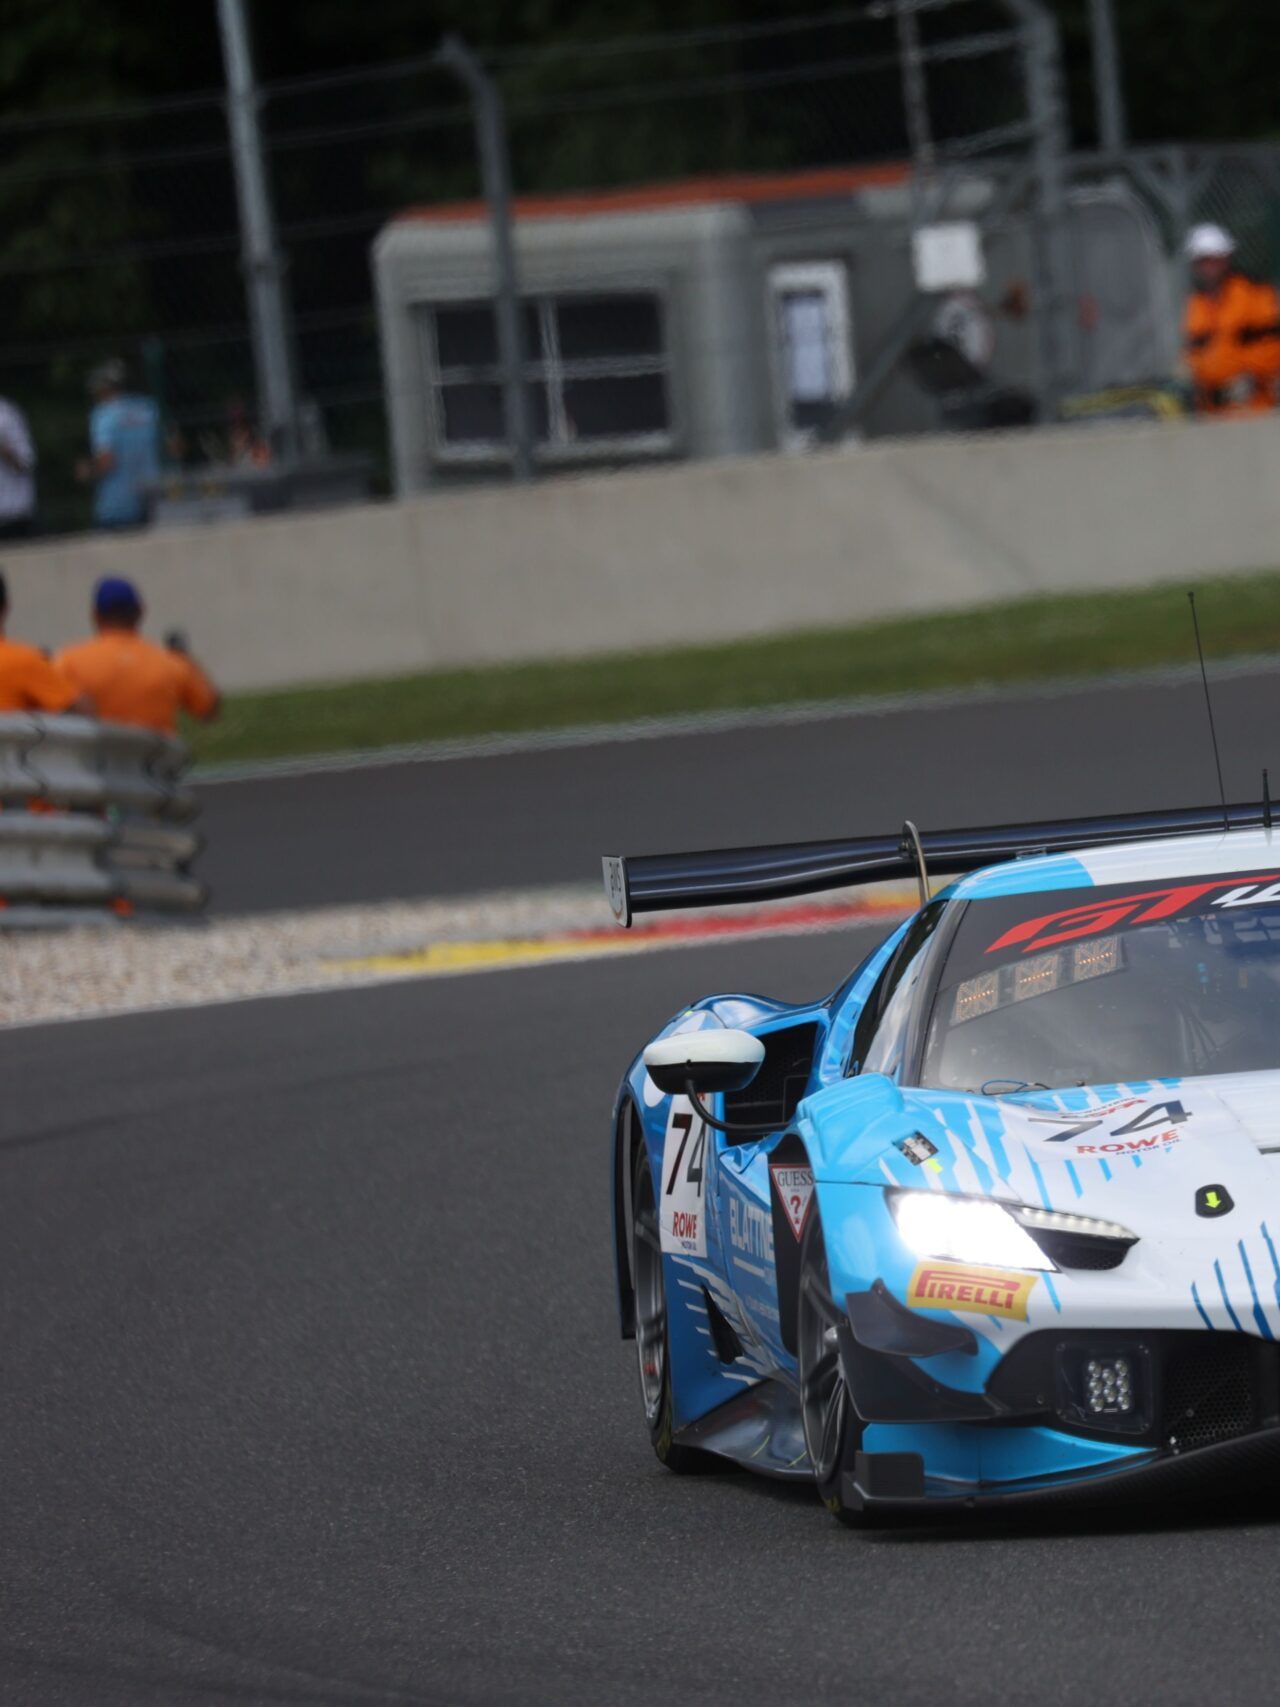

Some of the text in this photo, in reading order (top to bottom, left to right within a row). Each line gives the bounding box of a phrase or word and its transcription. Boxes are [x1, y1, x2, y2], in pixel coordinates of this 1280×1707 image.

[1028, 1099, 1193, 1142] 74
[666, 1112, 707, 1198] 74
[1076, 1129, 1179, 1154] ROWE
[777, 1171, 815, 1187] GUESS
[672, 1211, 697, 1239] ROWE
[915, 1269, 1021, 1309] PIRELLI
